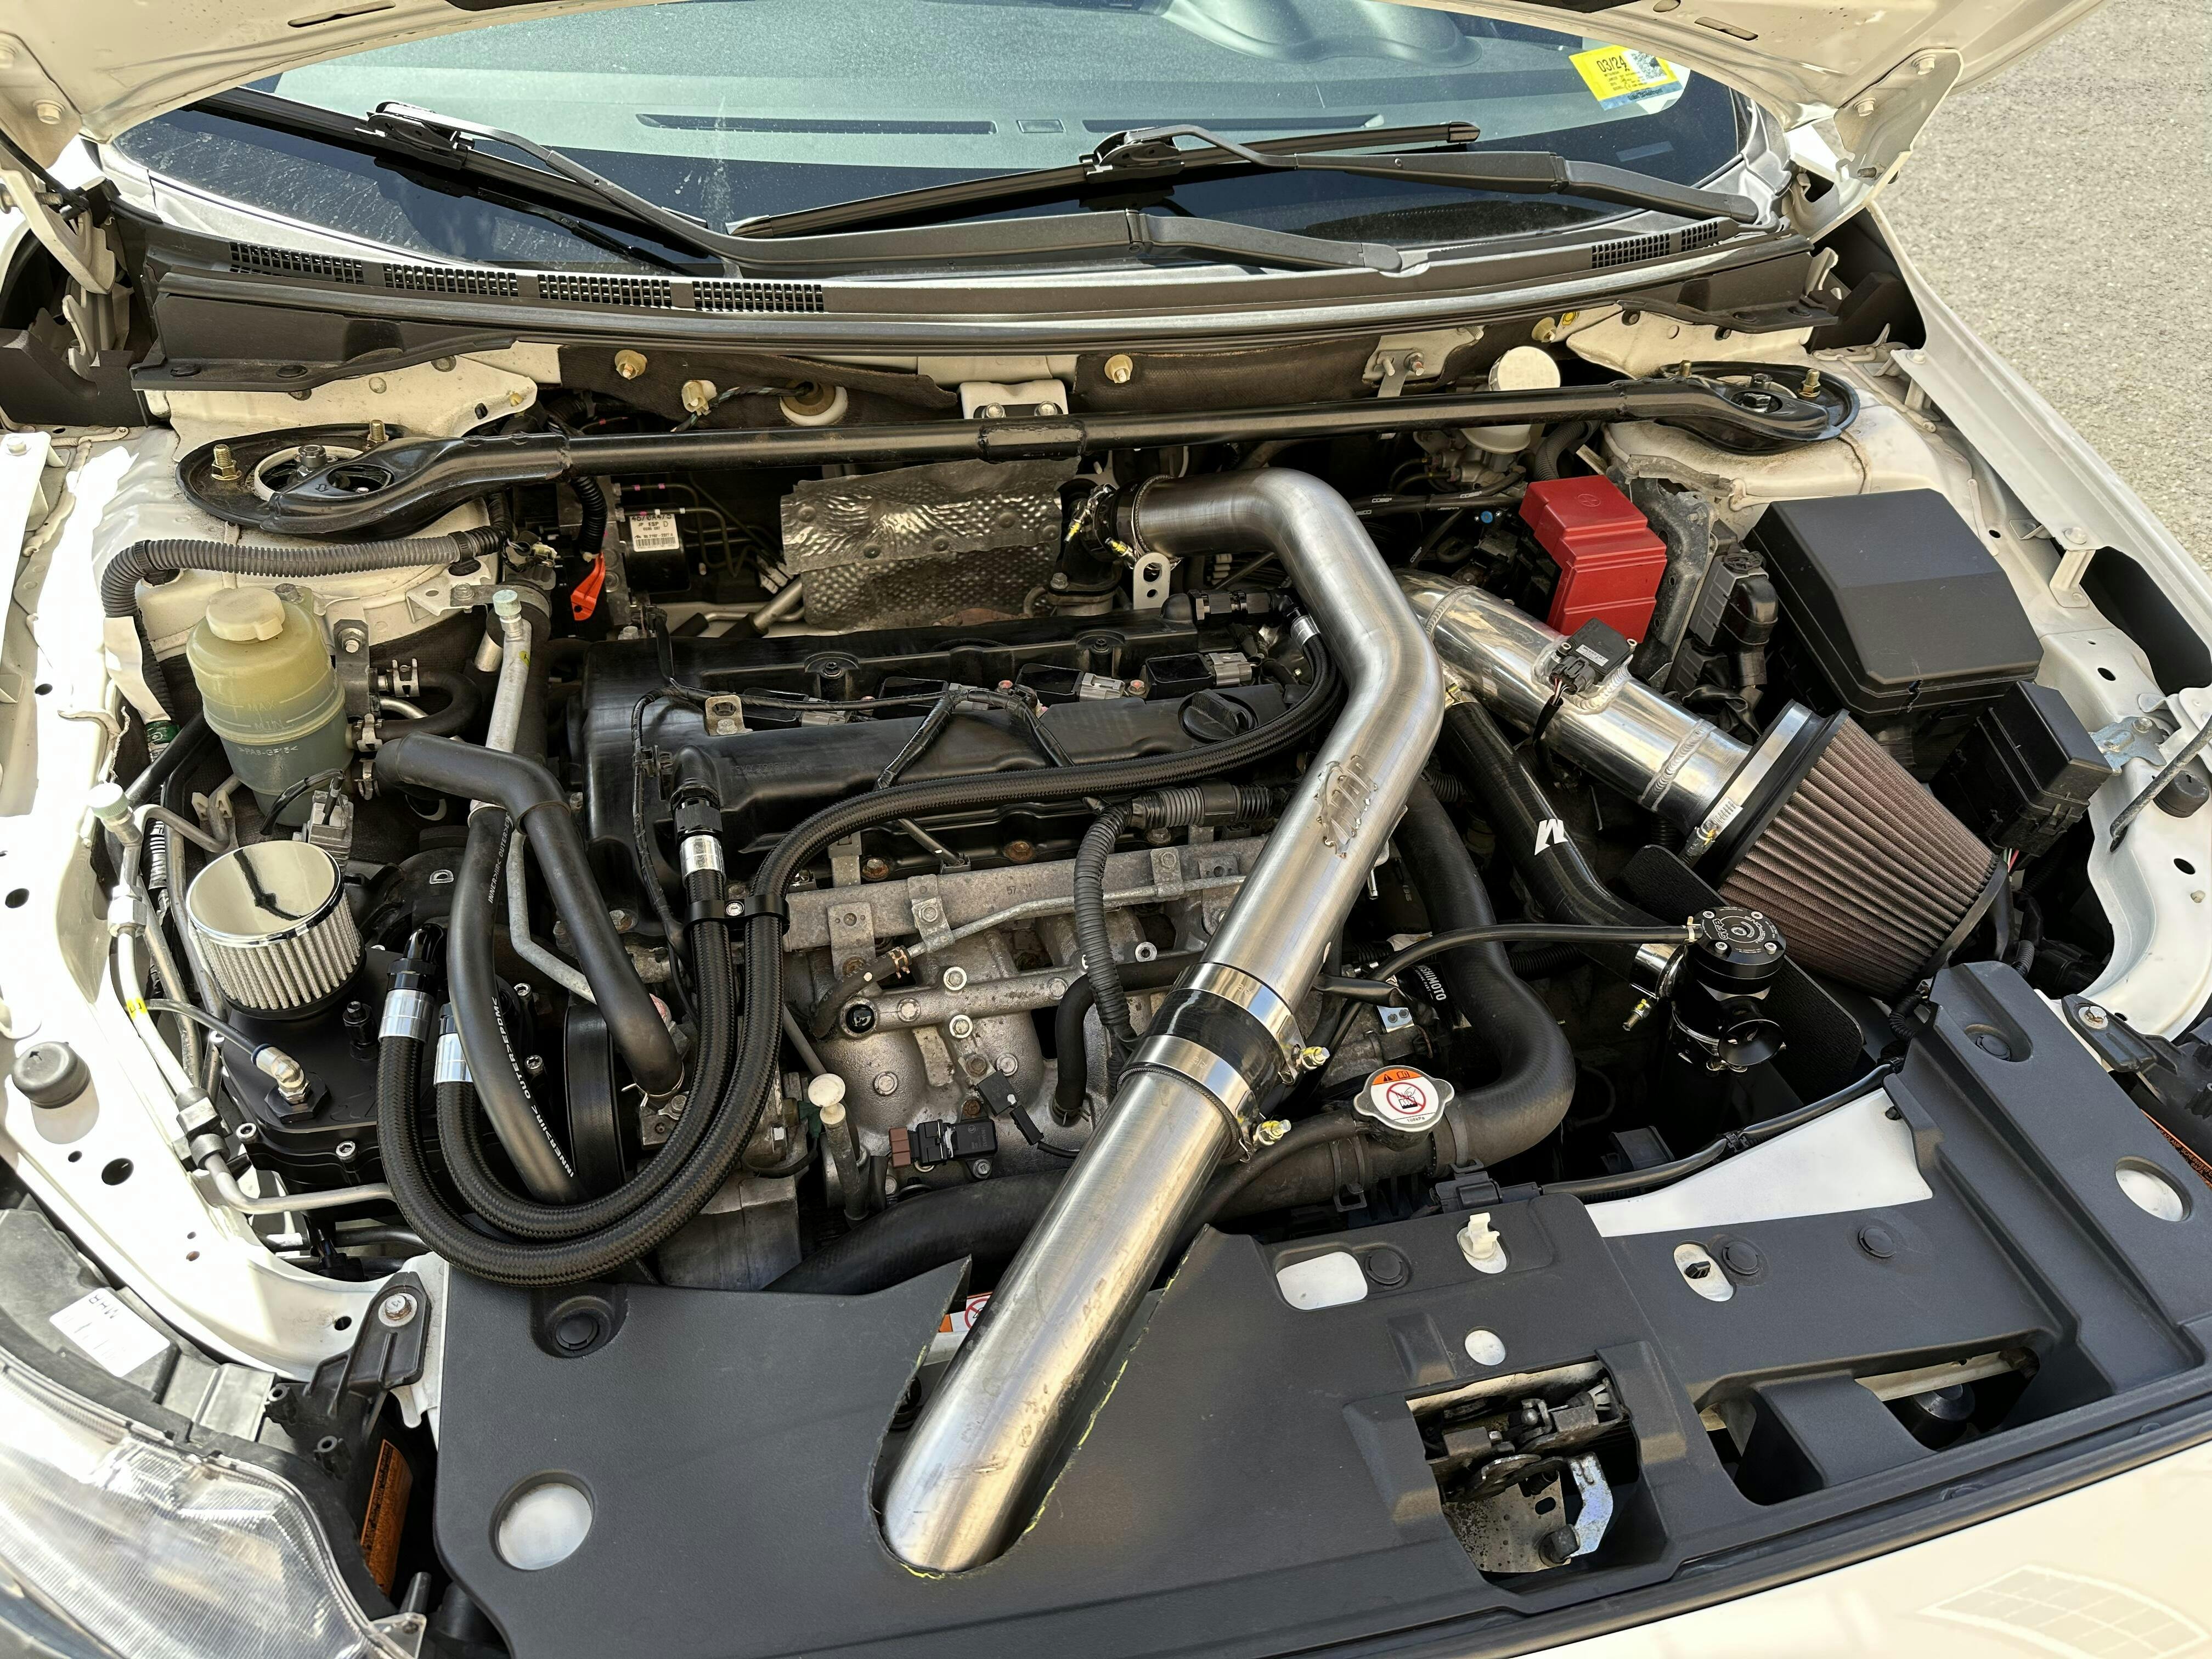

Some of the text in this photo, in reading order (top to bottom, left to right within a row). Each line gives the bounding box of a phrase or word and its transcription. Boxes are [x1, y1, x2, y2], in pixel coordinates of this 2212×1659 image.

[248, 700, 275, 711] MAX
[254, 719, 283, 730] MIN
[492, 996, 531, 1099] OUTER>EPDM<
